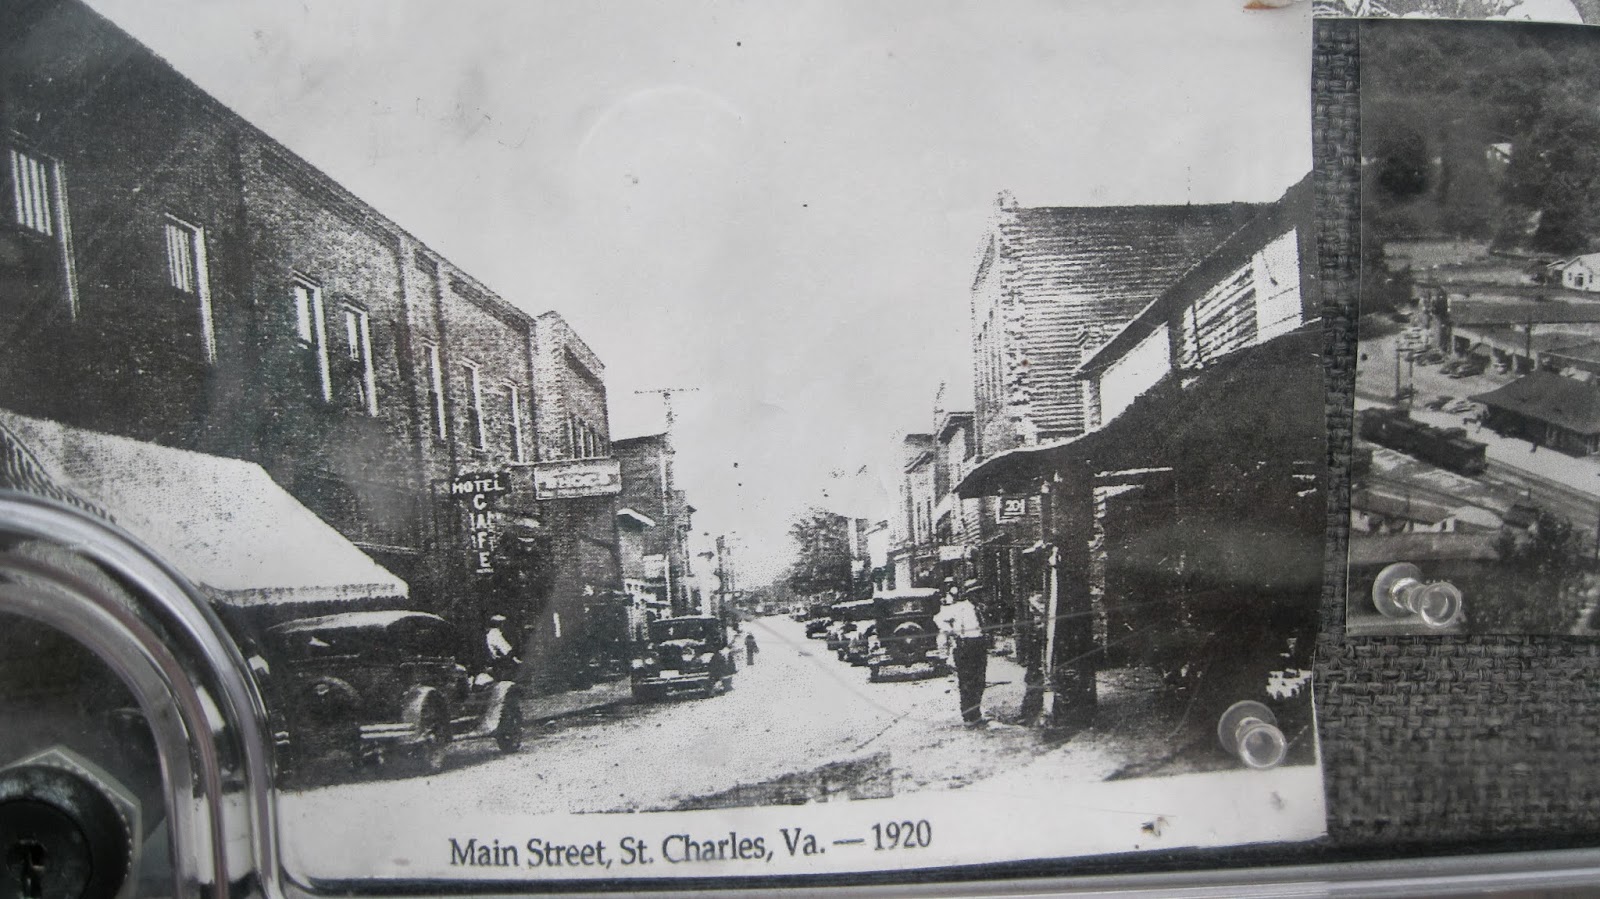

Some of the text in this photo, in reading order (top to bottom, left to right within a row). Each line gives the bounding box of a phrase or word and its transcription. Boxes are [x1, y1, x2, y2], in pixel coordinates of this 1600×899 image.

[472, 493, 491, 568] CAFE
[449, 838, 519, 867] Main
[526, 837, 613, 870] Street,
[619, 836, 654, 865] St.
[661, 833, 774, 863] Charles,
[780, 827, 826, 857] Va.
[871, 819, 932, 851] 1920
